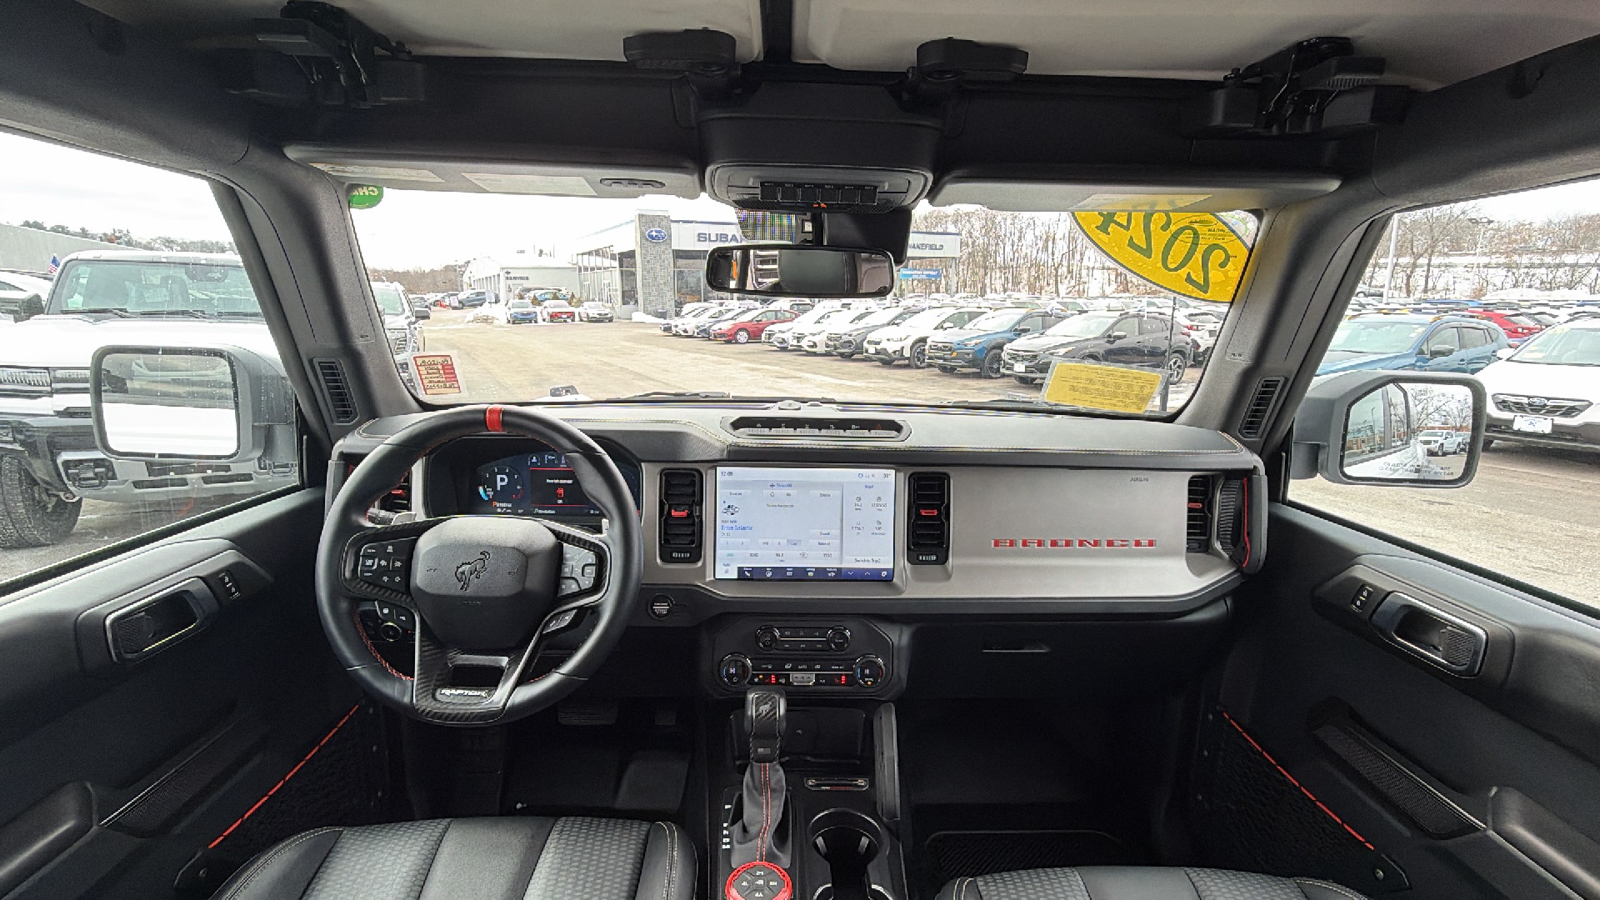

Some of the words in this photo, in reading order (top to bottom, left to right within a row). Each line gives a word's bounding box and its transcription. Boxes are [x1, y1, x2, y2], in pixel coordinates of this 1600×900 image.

[696, 232, 746, 244] SUBA
[496, 474, 509, 491] P
[990, 538, 1158, 549] BRONCO
